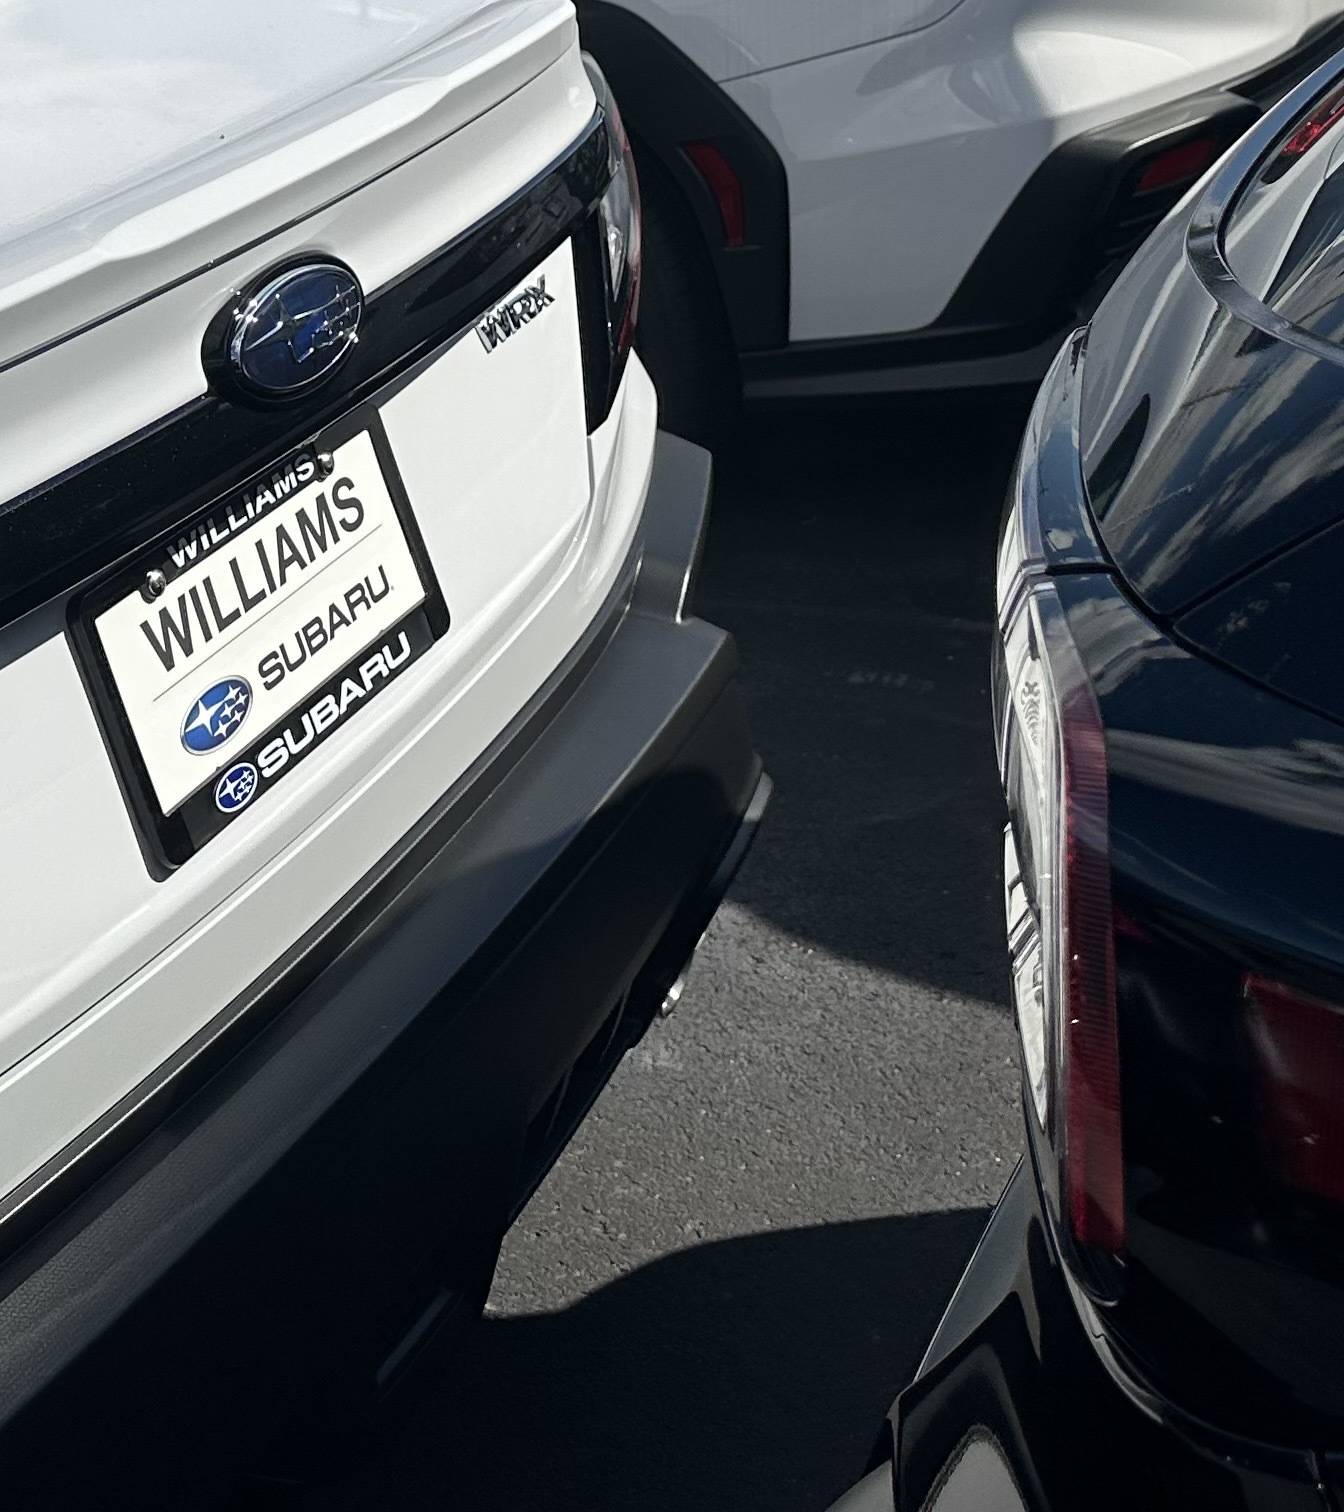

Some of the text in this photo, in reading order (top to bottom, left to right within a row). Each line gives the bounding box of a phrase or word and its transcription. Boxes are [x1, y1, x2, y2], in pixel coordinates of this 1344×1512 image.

[475, 274, 555, 354] WRX
[140, 476, 365, 673] WILLIAMS
[166, 453, 316, 570] WILLIAMS
[258, 564, 391, 691] SUBARU
[257, 630, 412, 778] SUBARU
